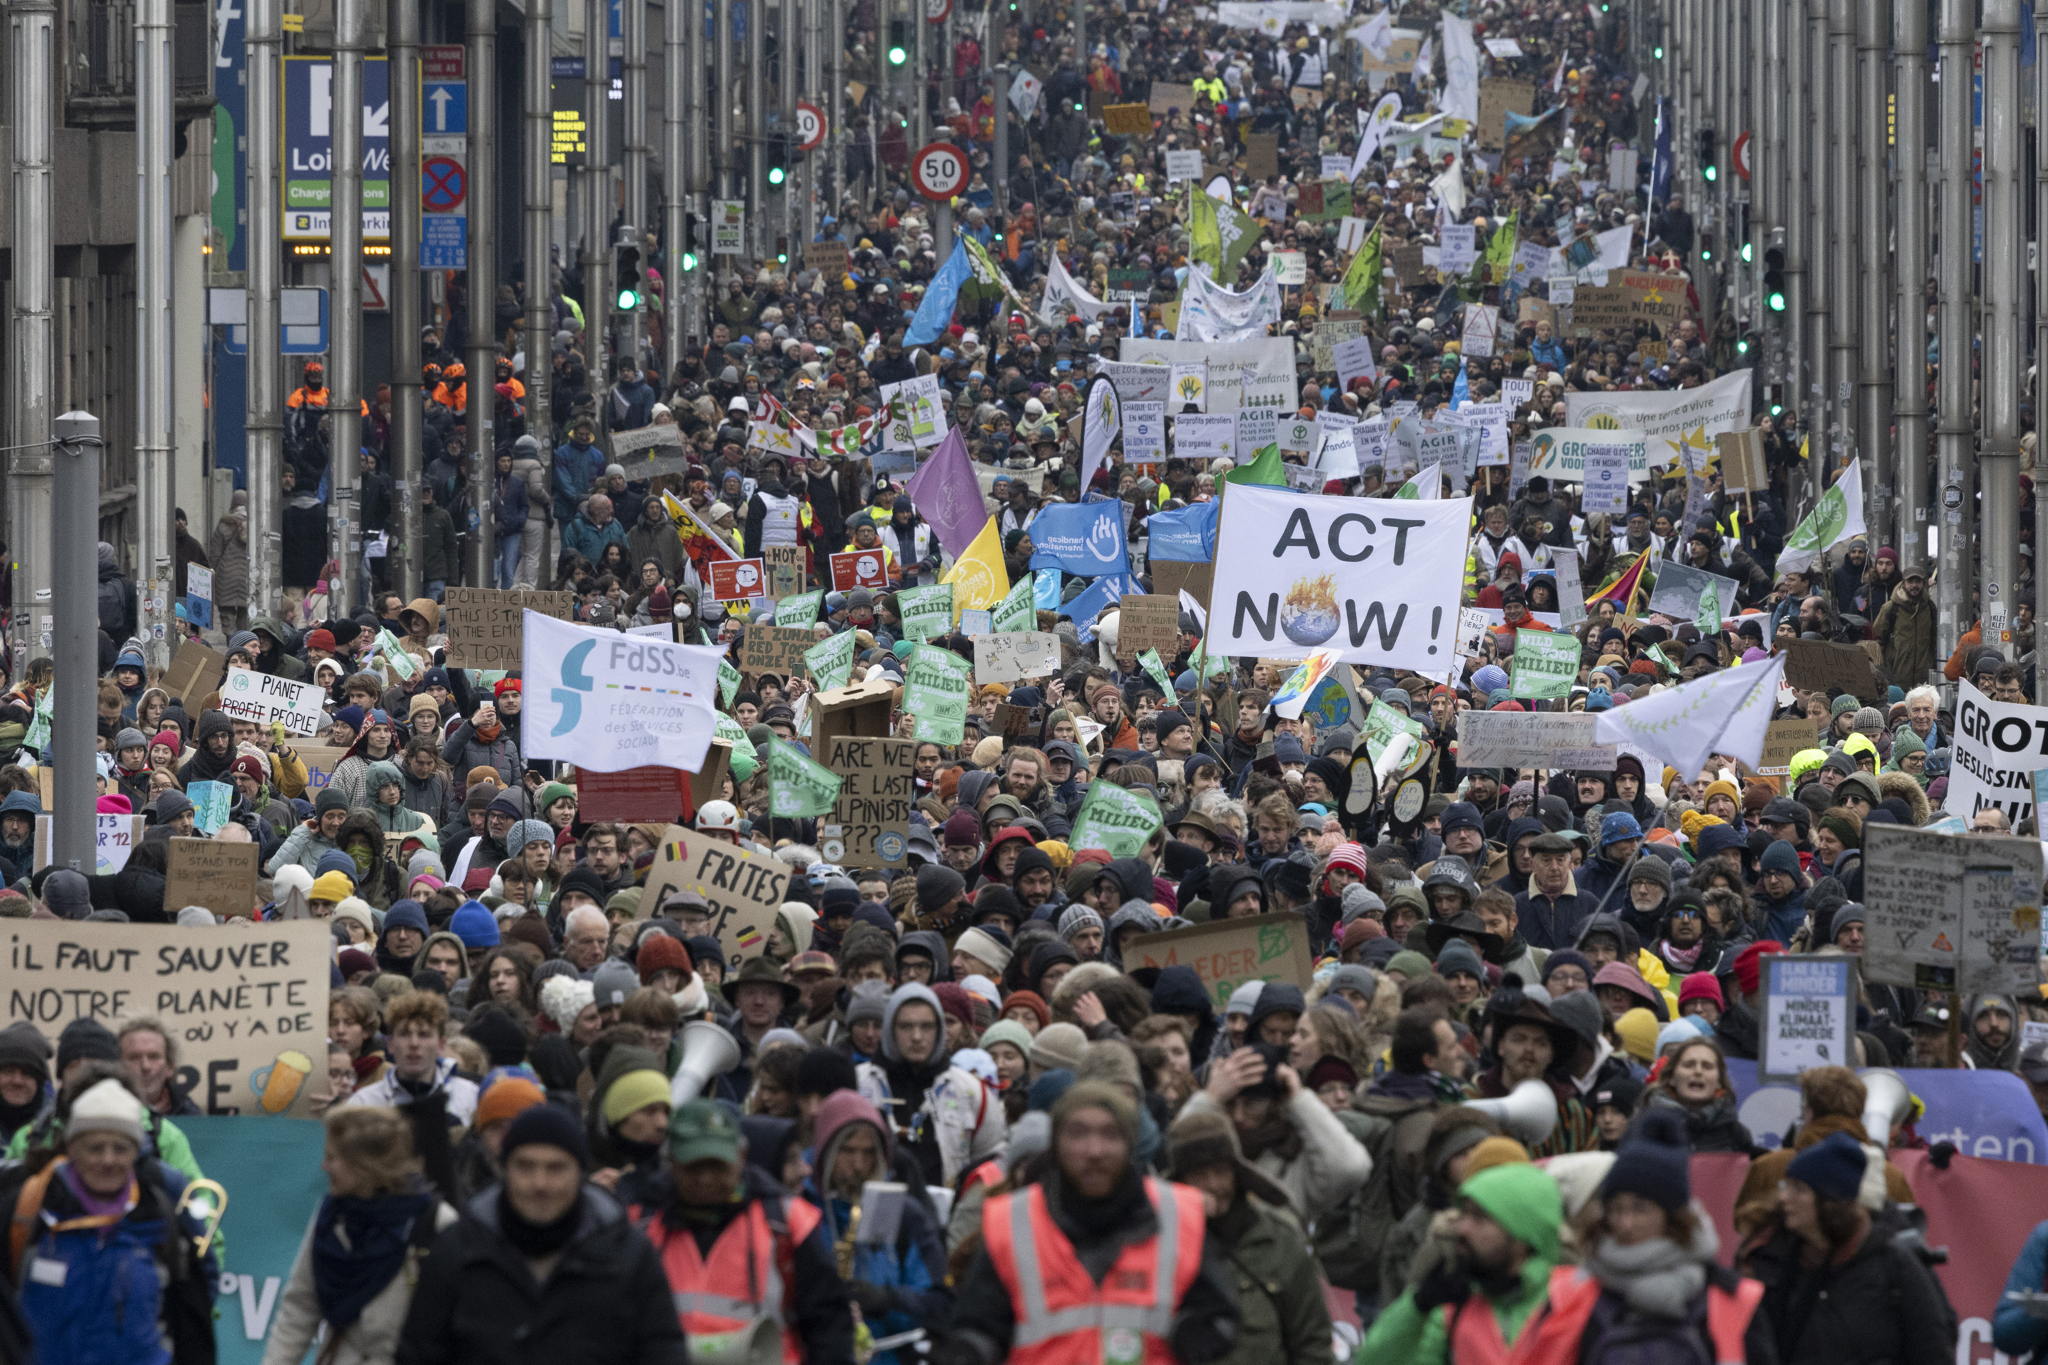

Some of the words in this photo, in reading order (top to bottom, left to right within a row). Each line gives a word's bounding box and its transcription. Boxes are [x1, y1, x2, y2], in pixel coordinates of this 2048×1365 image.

[801, 115, 815, 132] 0
[925, 158, 957, 179] 50
[932, 178, 949, 189] km
[291, 187, 331, 201] Chargin
[1208, 364, 1228, 373] erre
[1208, 379, 1225, 388] nos
[1227, 374, 1291, 388] pet-enfants
[1504, 380, 1531, 392] TOUT
[1240, 409, 1275, 422] AGIR
[1635, 412, 1656, 424] Une
[1690, 398, 1714, 410] vivre
[1662, 423, 1680, 434] nos
[1420, 435, 1456, 449] AGIR
[1272, 507, 1427, 567] ACT
[447, 589, 569, 609] POLITICIANS
[446, 607, 480, 623] THIS
[501, 609, 521, 623] TH
[1231, 590, 1410, 653] NW
[464, 625, 485, 638] THE
[1520, 634, 1553, 648] WILD
[747, 655, 783, 668] ONZE
[1540, 647, 1578, 661] VOOR
[1515, 655, 1576, 676] MILIEU
[261, 675, 305, 702] PLANET
[610, 702, 686, 718] FÉDÉRATION
[269, 706, 317, 734] PEOPLE
[604, 723, 627, 735] des
[830, 741, 874, 769] ARE
[883, 742, 914, 768] WE
[1955, 744, 2031, 791] BESLISSIN
[839, 772, 860, 796] HE
[872, 774, 913, 796] LAST
[1088, 806, 1156, 831] MILIEU
[112, 832, 131, 847] 12
[188, 857, 225, 867] STAND
[227, 857, 249, 869] FOR
[696, 848, 787, 907] FRITES
[56, 942, 140, 973] FAUT
[155, 941, 291, 976] SAUVER
[1143, 945, 1259, 982] MEDER
[9, 988, 131, 1022] NOTRE
[157, 974, 308, 1016] PLANÈTE
[1785, 1000, 1831, 1012] MINDER
[185, 1019, 214, 1042] OÙ
[278, 1013, 313, 1034] DE
